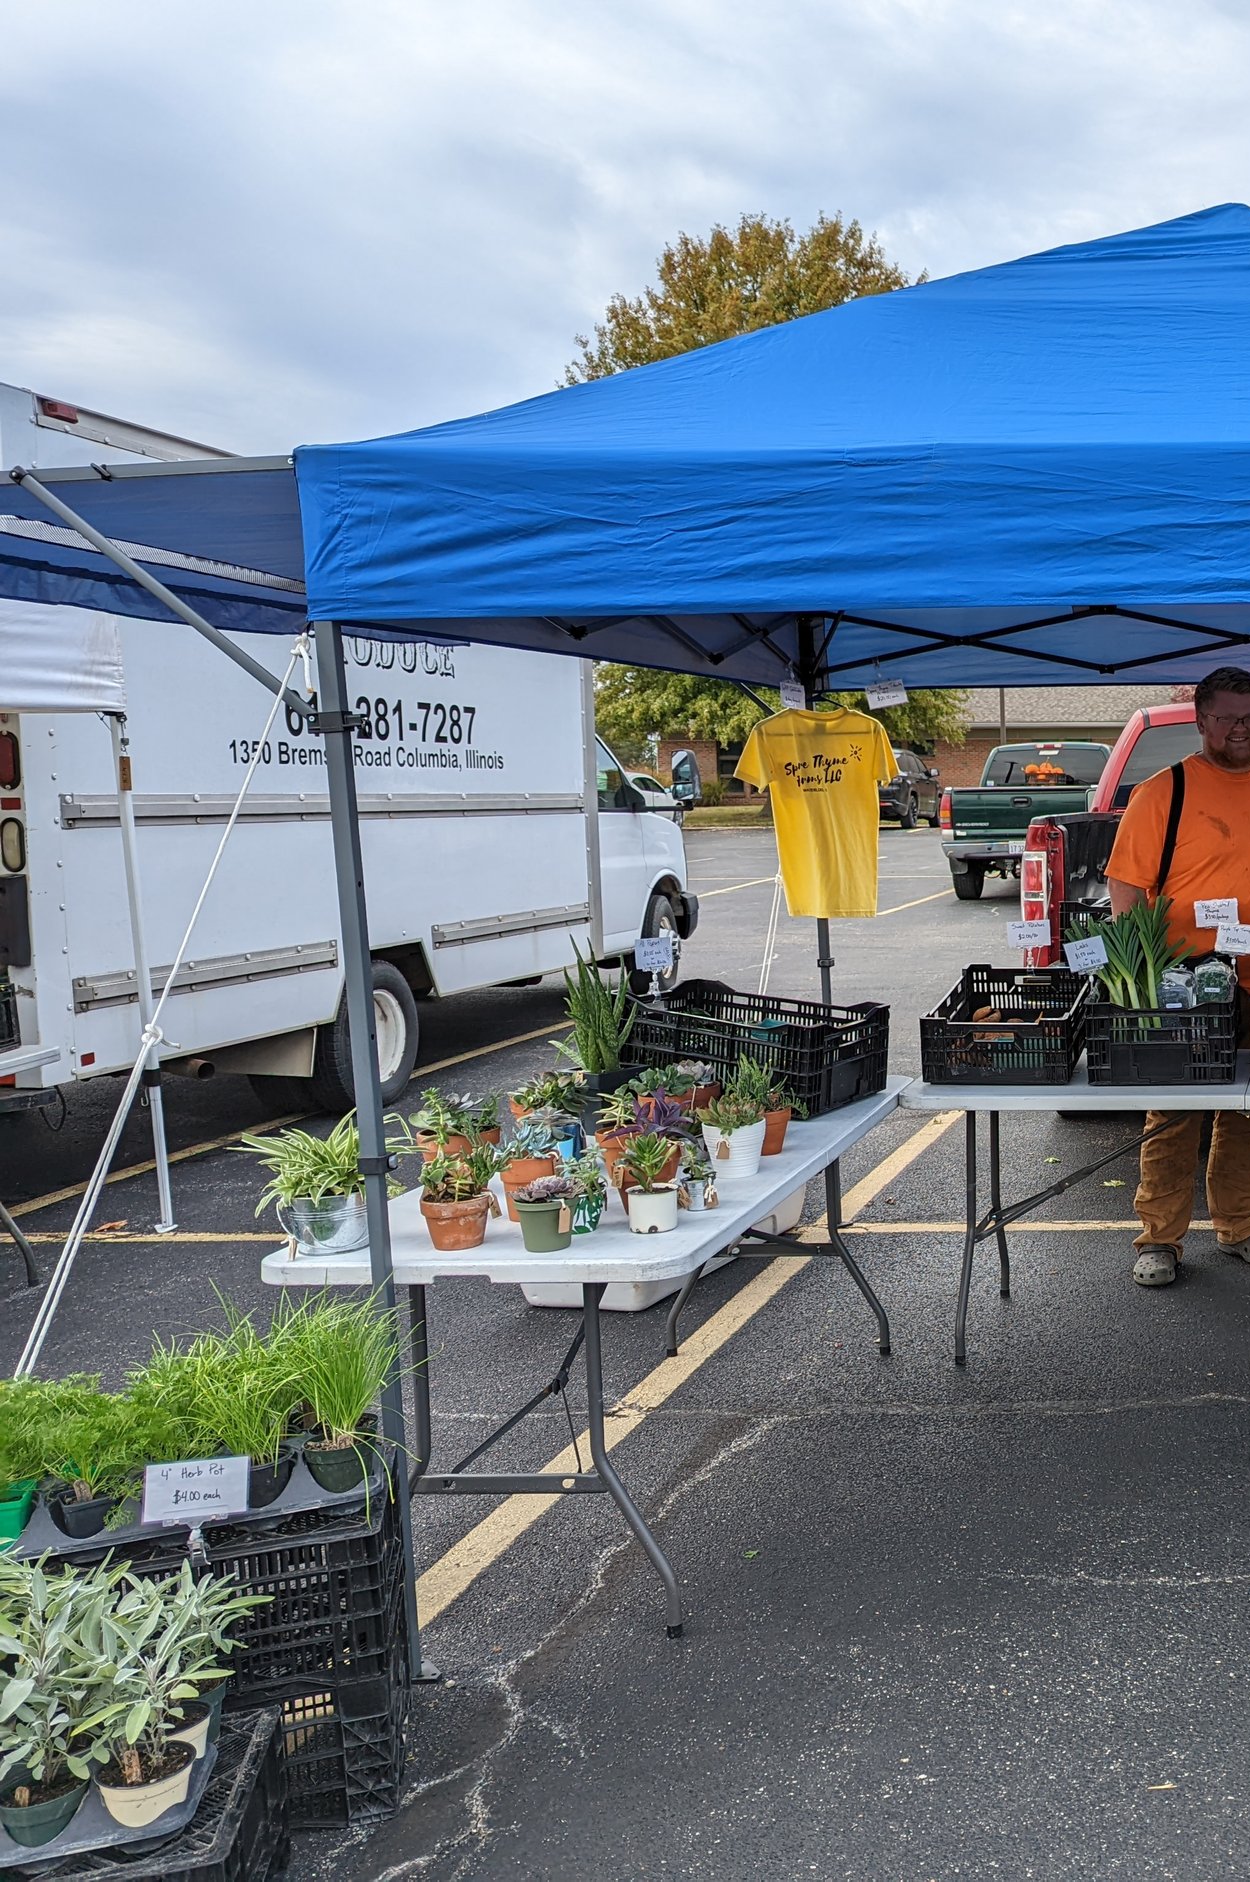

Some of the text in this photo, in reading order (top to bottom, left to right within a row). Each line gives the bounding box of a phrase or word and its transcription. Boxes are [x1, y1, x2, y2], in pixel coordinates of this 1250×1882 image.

[228, 739, 271, 765] 1350
[354, 744, 392, 767] Road
[396, 748, 463, 772] Columbia,
[466, 750, 505, 770] Illinois
[812, 754, 848, 772] Thyme
[824, 769, 842, 783] LLC
[181, 1465, 203, 1479] Herb
[209, 1462, 225, 1476] Pot
[172, 1488, 222, 1504] $4.00 each
